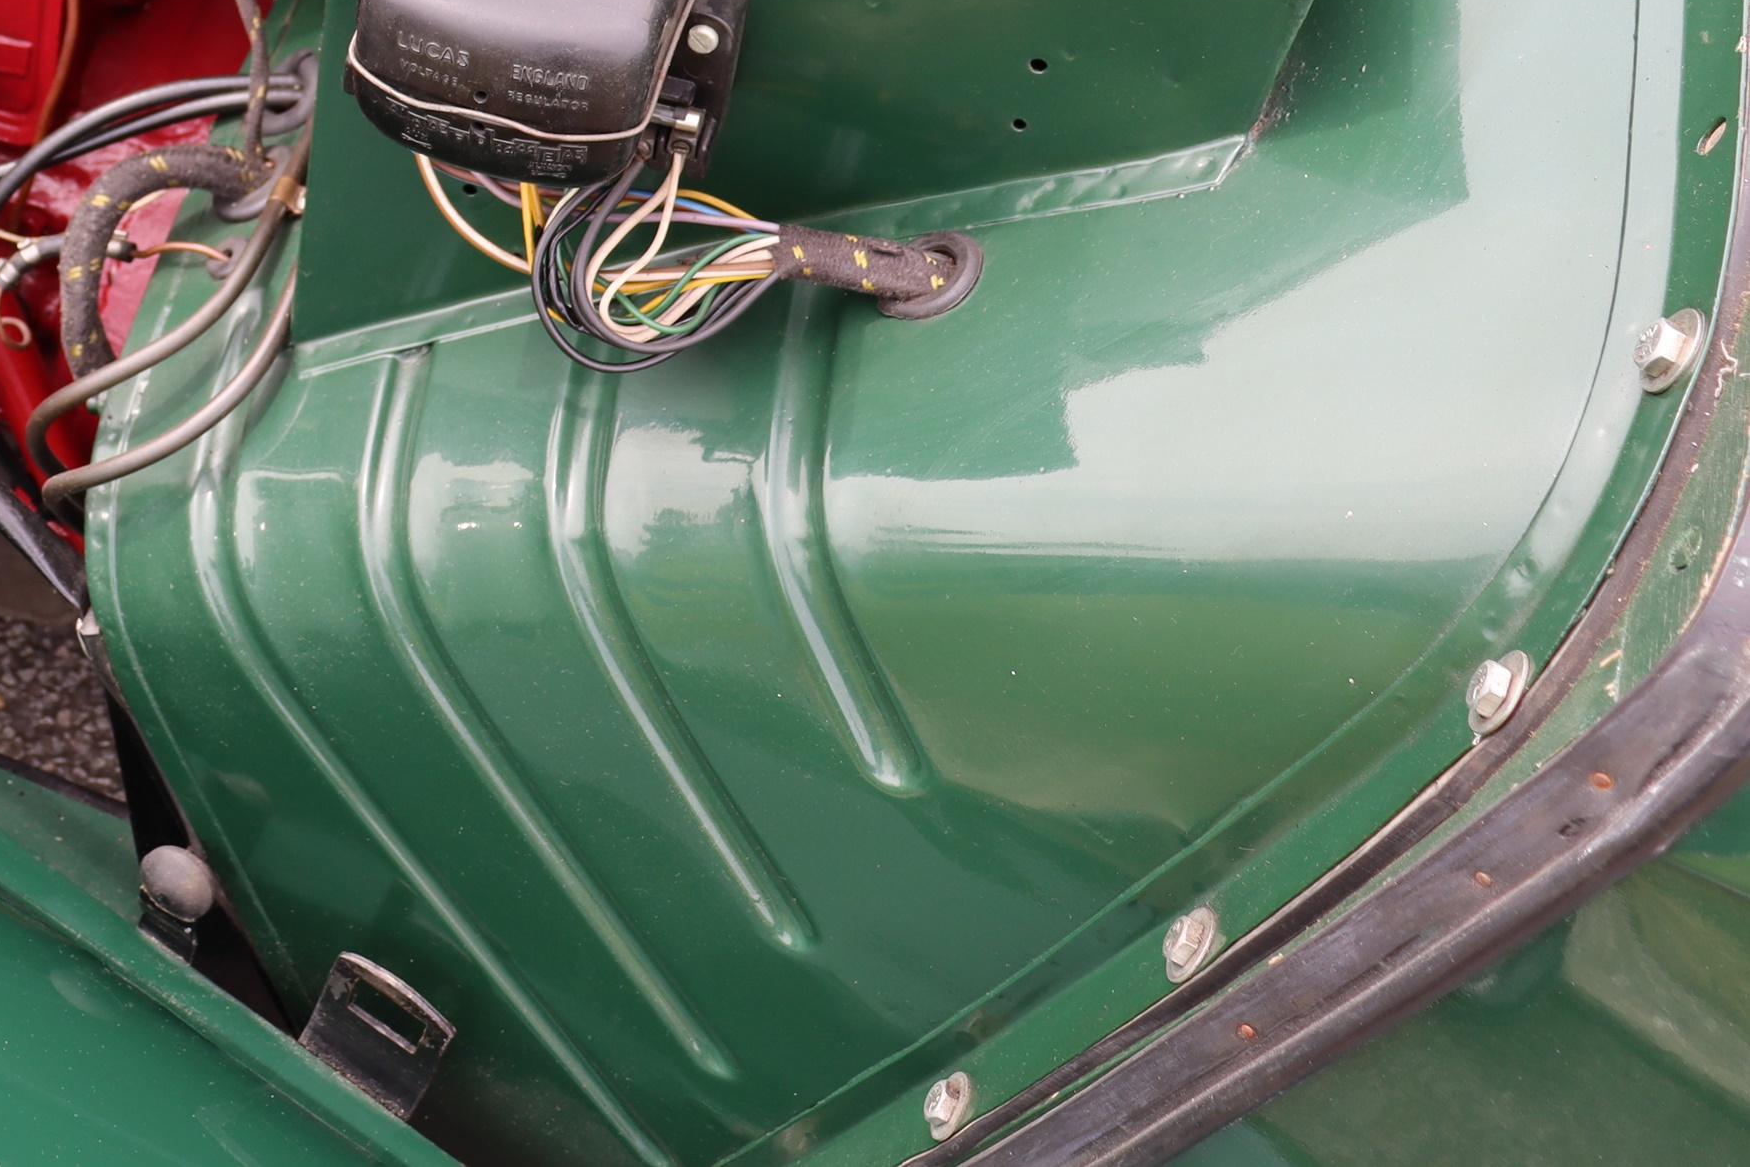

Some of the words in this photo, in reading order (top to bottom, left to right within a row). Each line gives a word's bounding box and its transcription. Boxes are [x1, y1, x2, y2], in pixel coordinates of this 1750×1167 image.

[396, 30, 470, 69] LUCAS
[399, 57, 459, 87] VOLTAGE
[511, 63, 590, 92] ENGLAND
[507, 89, 590, 112] REGULATOR
